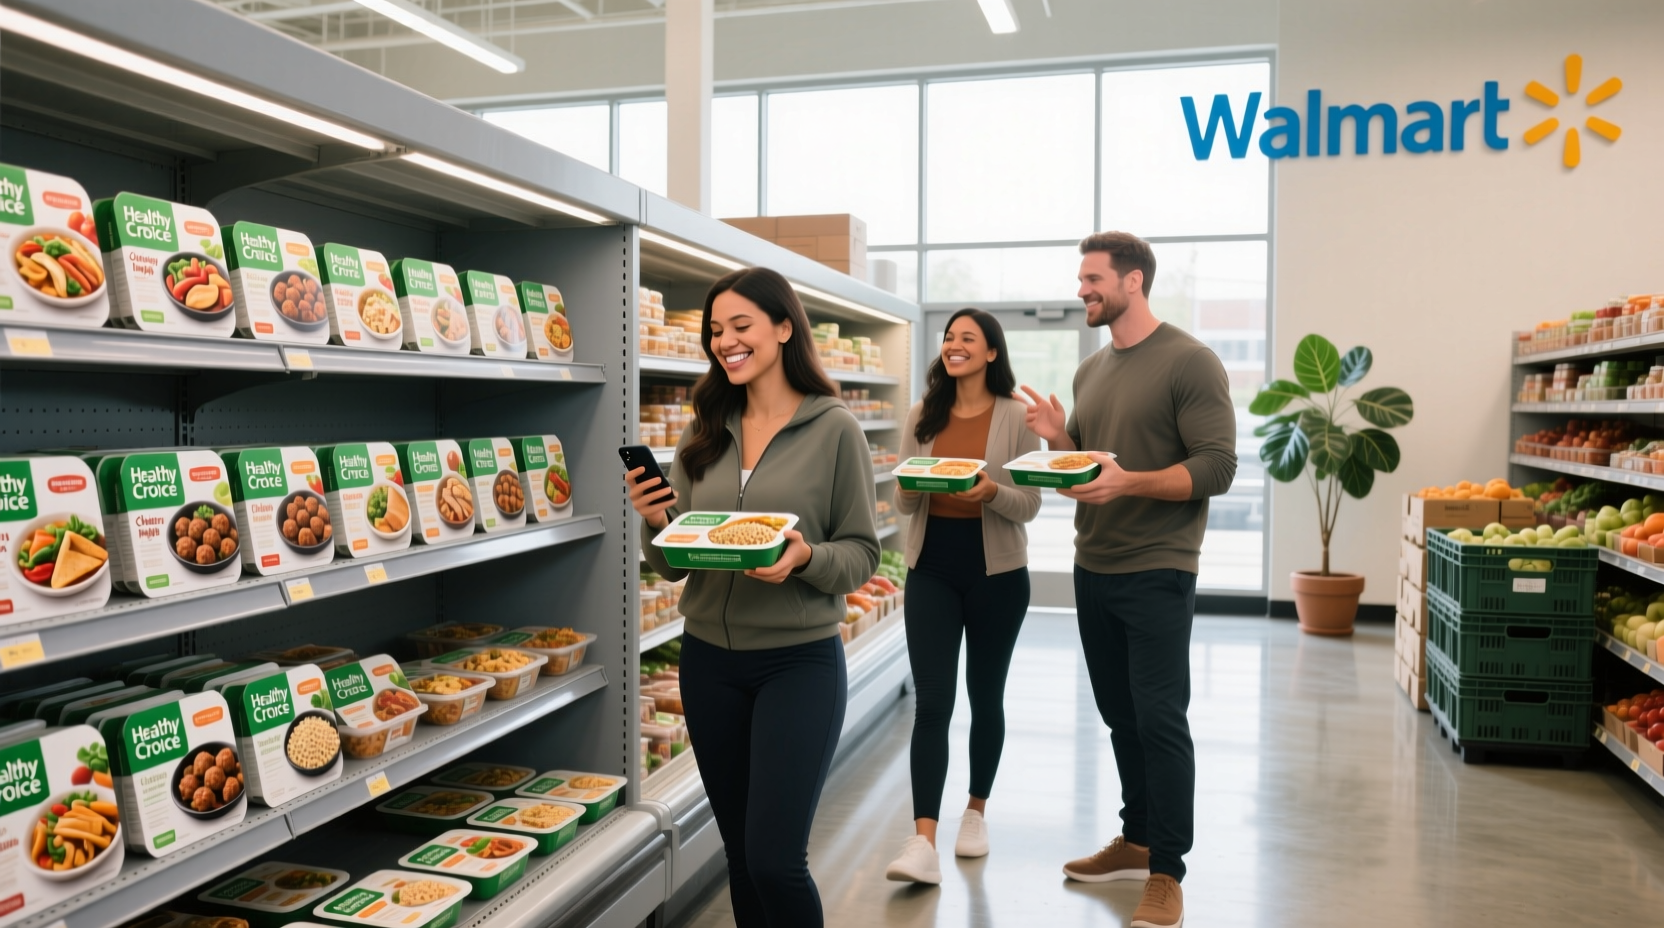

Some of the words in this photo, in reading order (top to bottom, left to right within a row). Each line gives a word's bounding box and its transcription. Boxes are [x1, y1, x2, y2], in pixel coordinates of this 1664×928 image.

[1180, 80, 1510, 161] Walmart
[130, 465, 176, 484] Healthy
[132, 717, 179, 744] Healthy
[0, 778, 41, 802] oice
